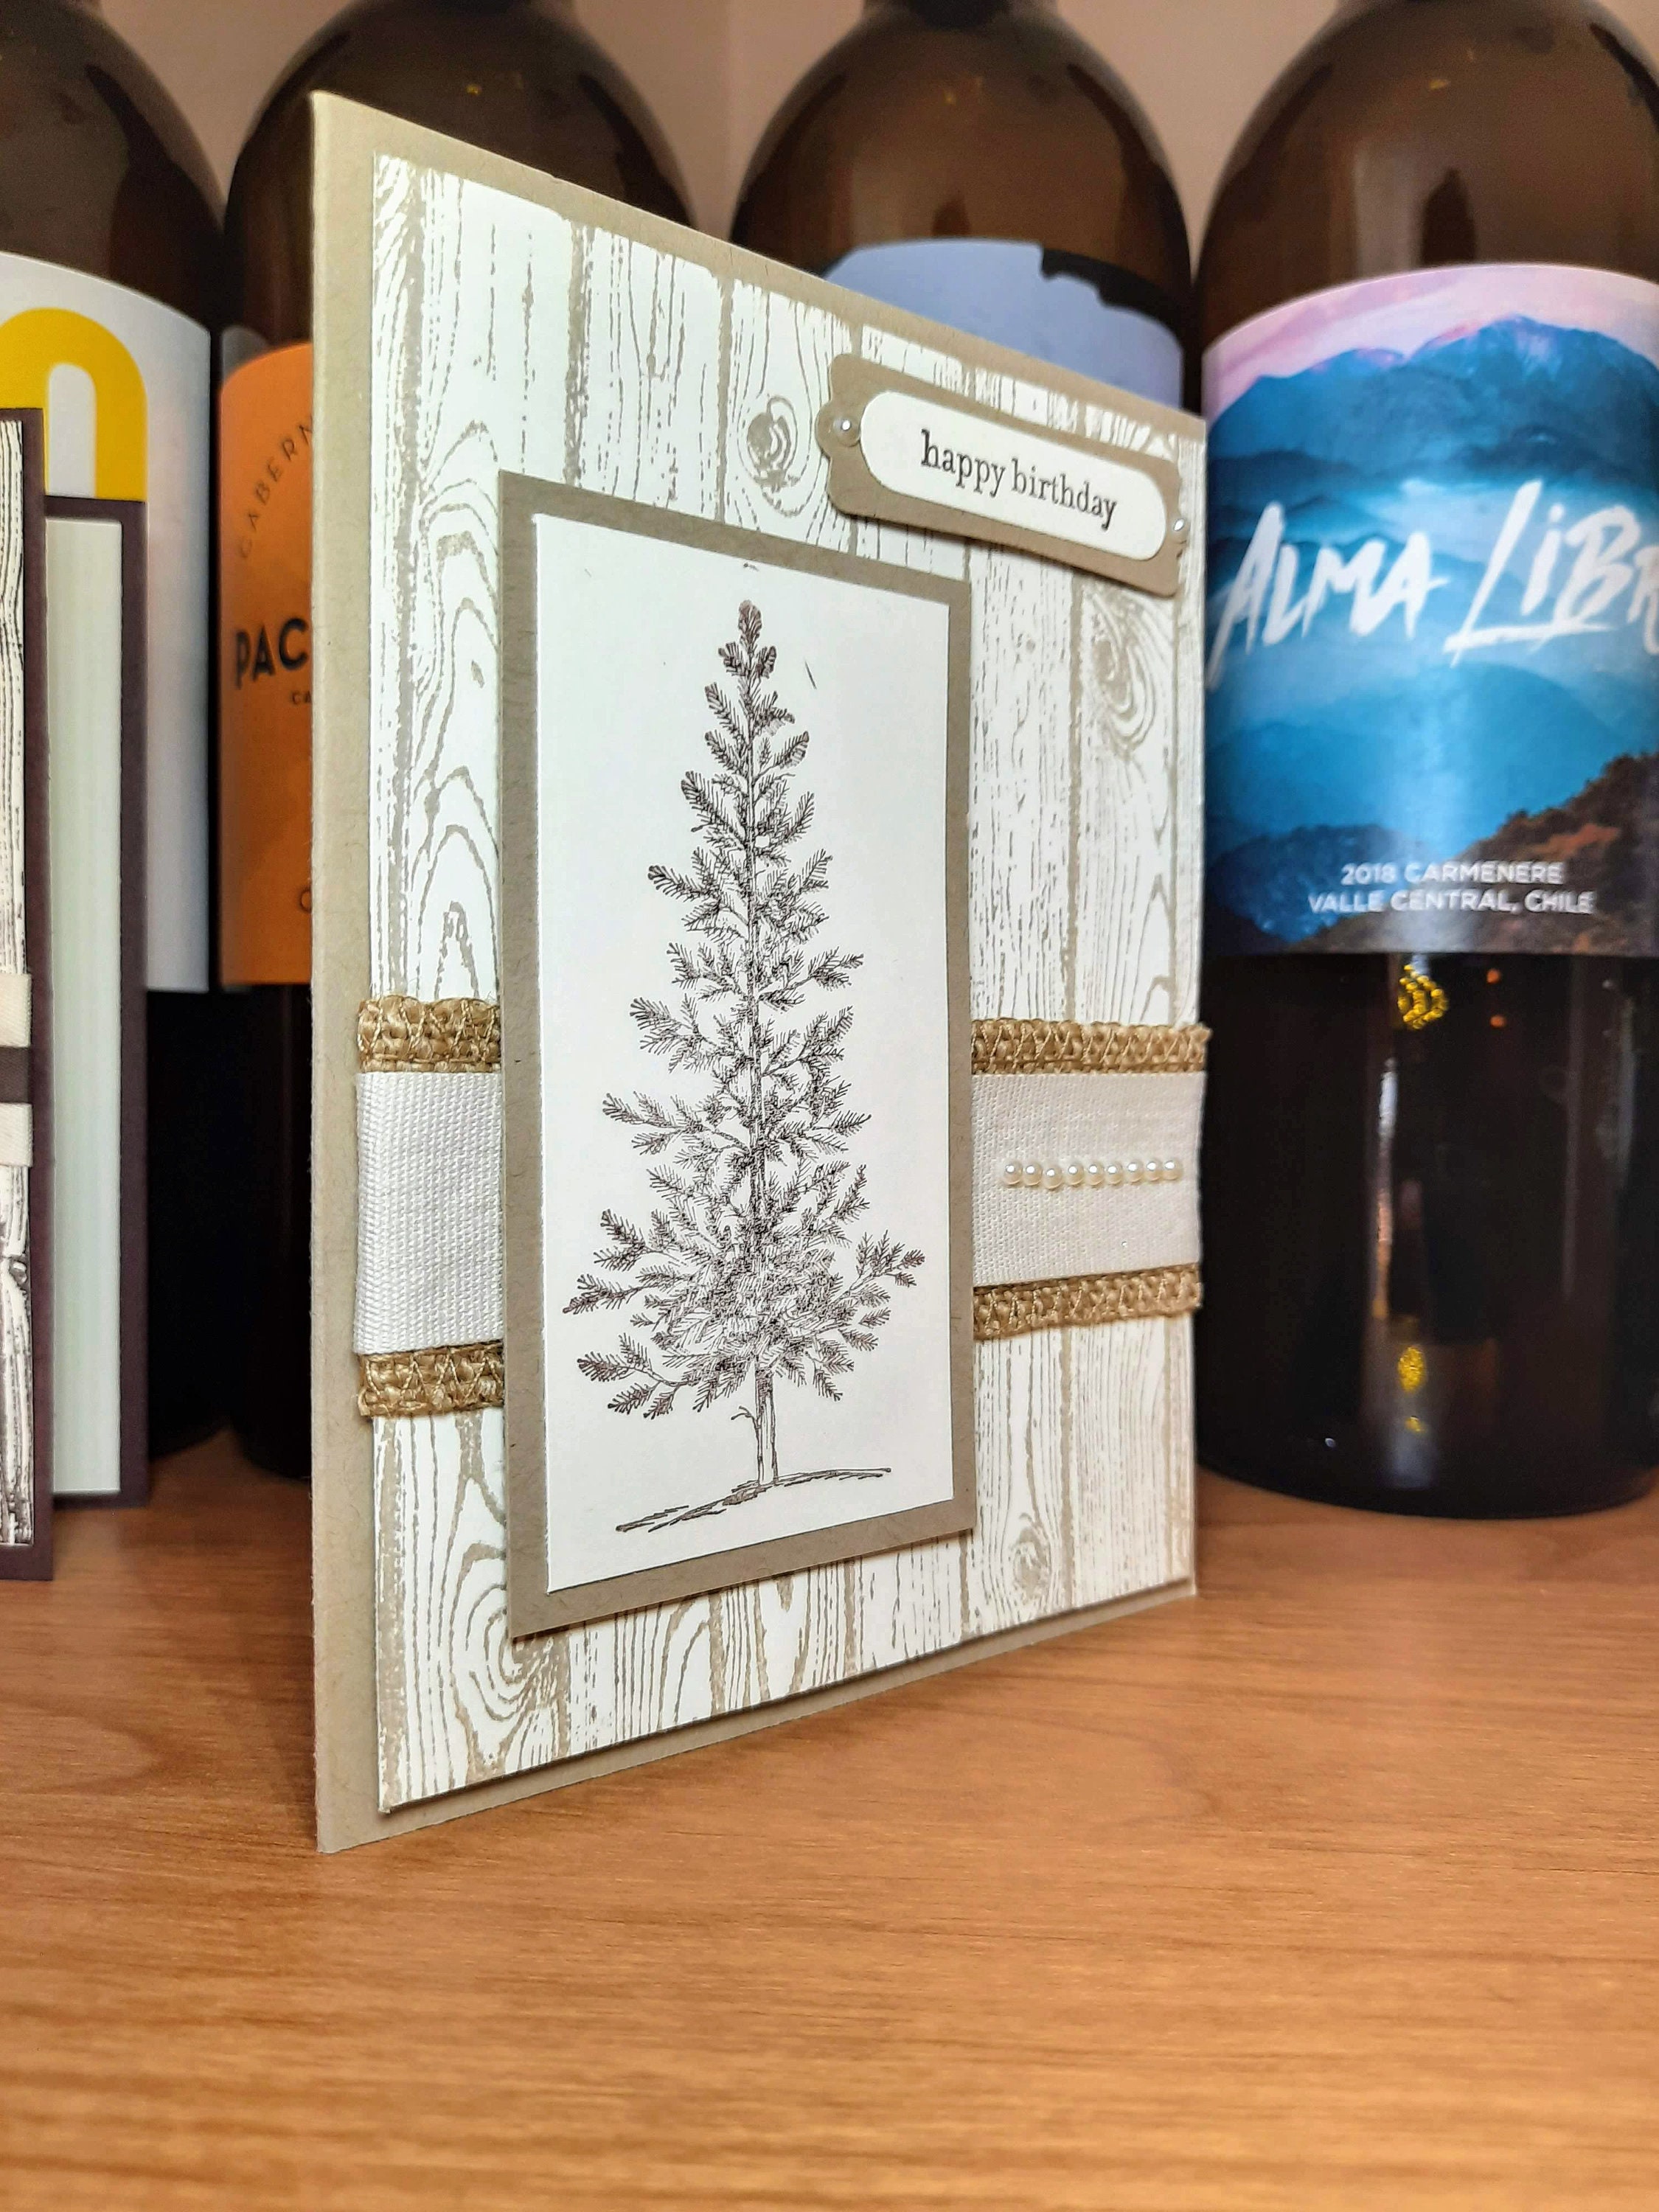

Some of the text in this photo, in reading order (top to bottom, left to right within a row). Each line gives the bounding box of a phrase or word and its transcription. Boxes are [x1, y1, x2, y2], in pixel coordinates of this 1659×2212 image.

[920, 428, 1117, 532] happy birthday
[1207, 502, 1451, 692] ALMA
[234, 617, 308, 690] PAC
[1308, 889, 1596, 914] VALLE CENTRAL, CHILE
[1340, 860, 1566, 886] 2018 CARMENERE
